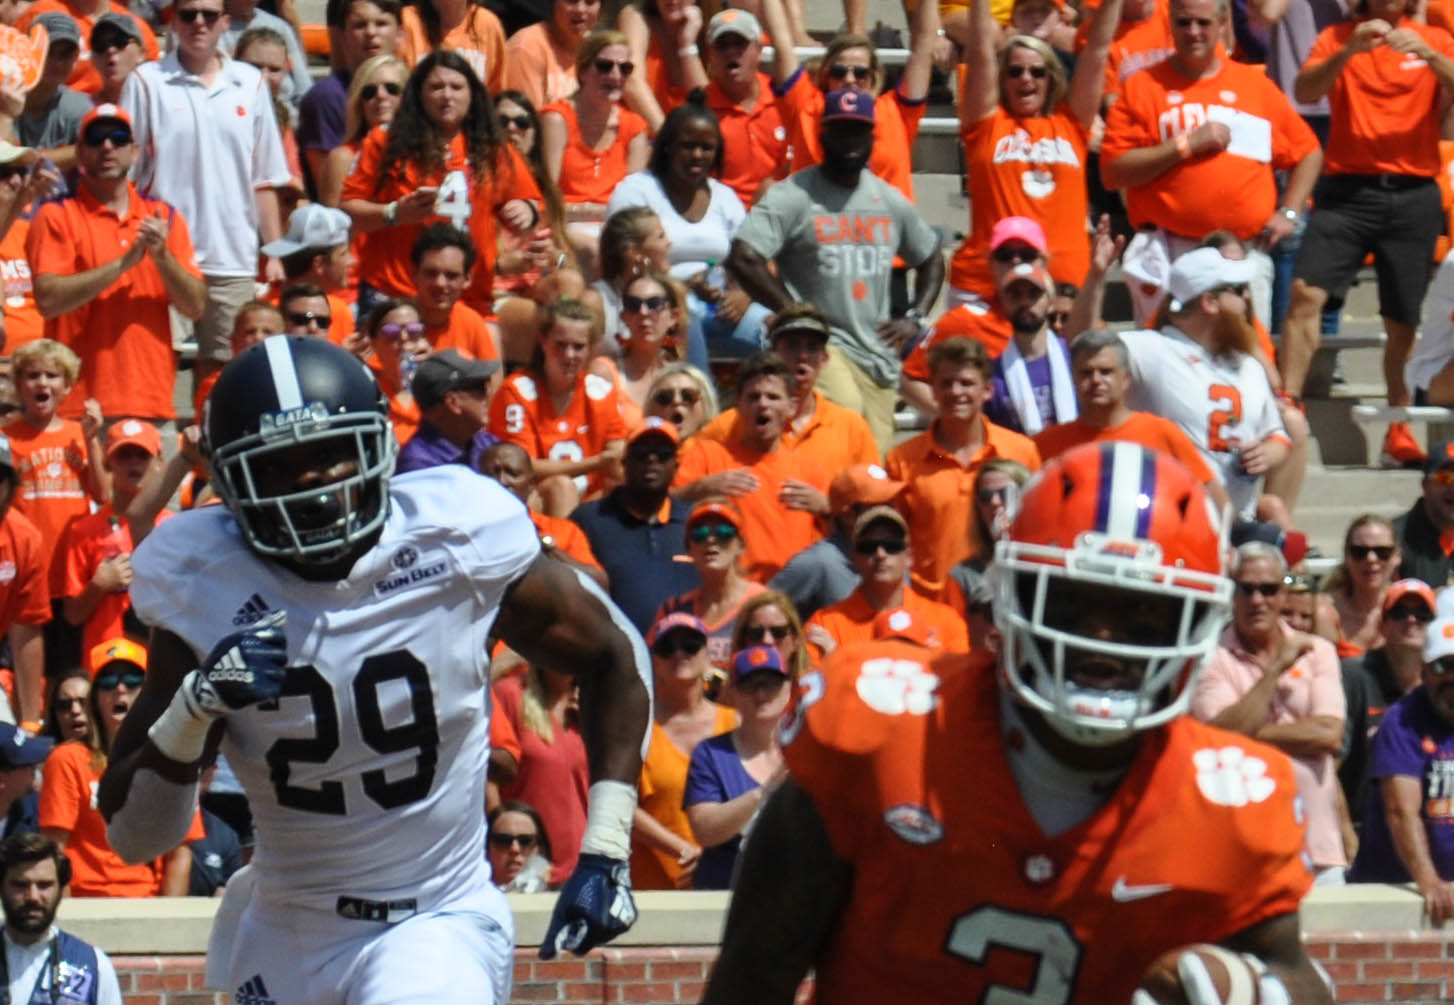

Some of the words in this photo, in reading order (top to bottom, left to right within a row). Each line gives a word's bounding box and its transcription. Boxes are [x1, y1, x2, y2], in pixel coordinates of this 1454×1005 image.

[436, 170, 471, 230] 4
[505, 404, 525, 433] 9
[1208, 384, 1242, 452] 2
[208, 670, 255, 684] adidas
[257, 648, 440, 816] 29
